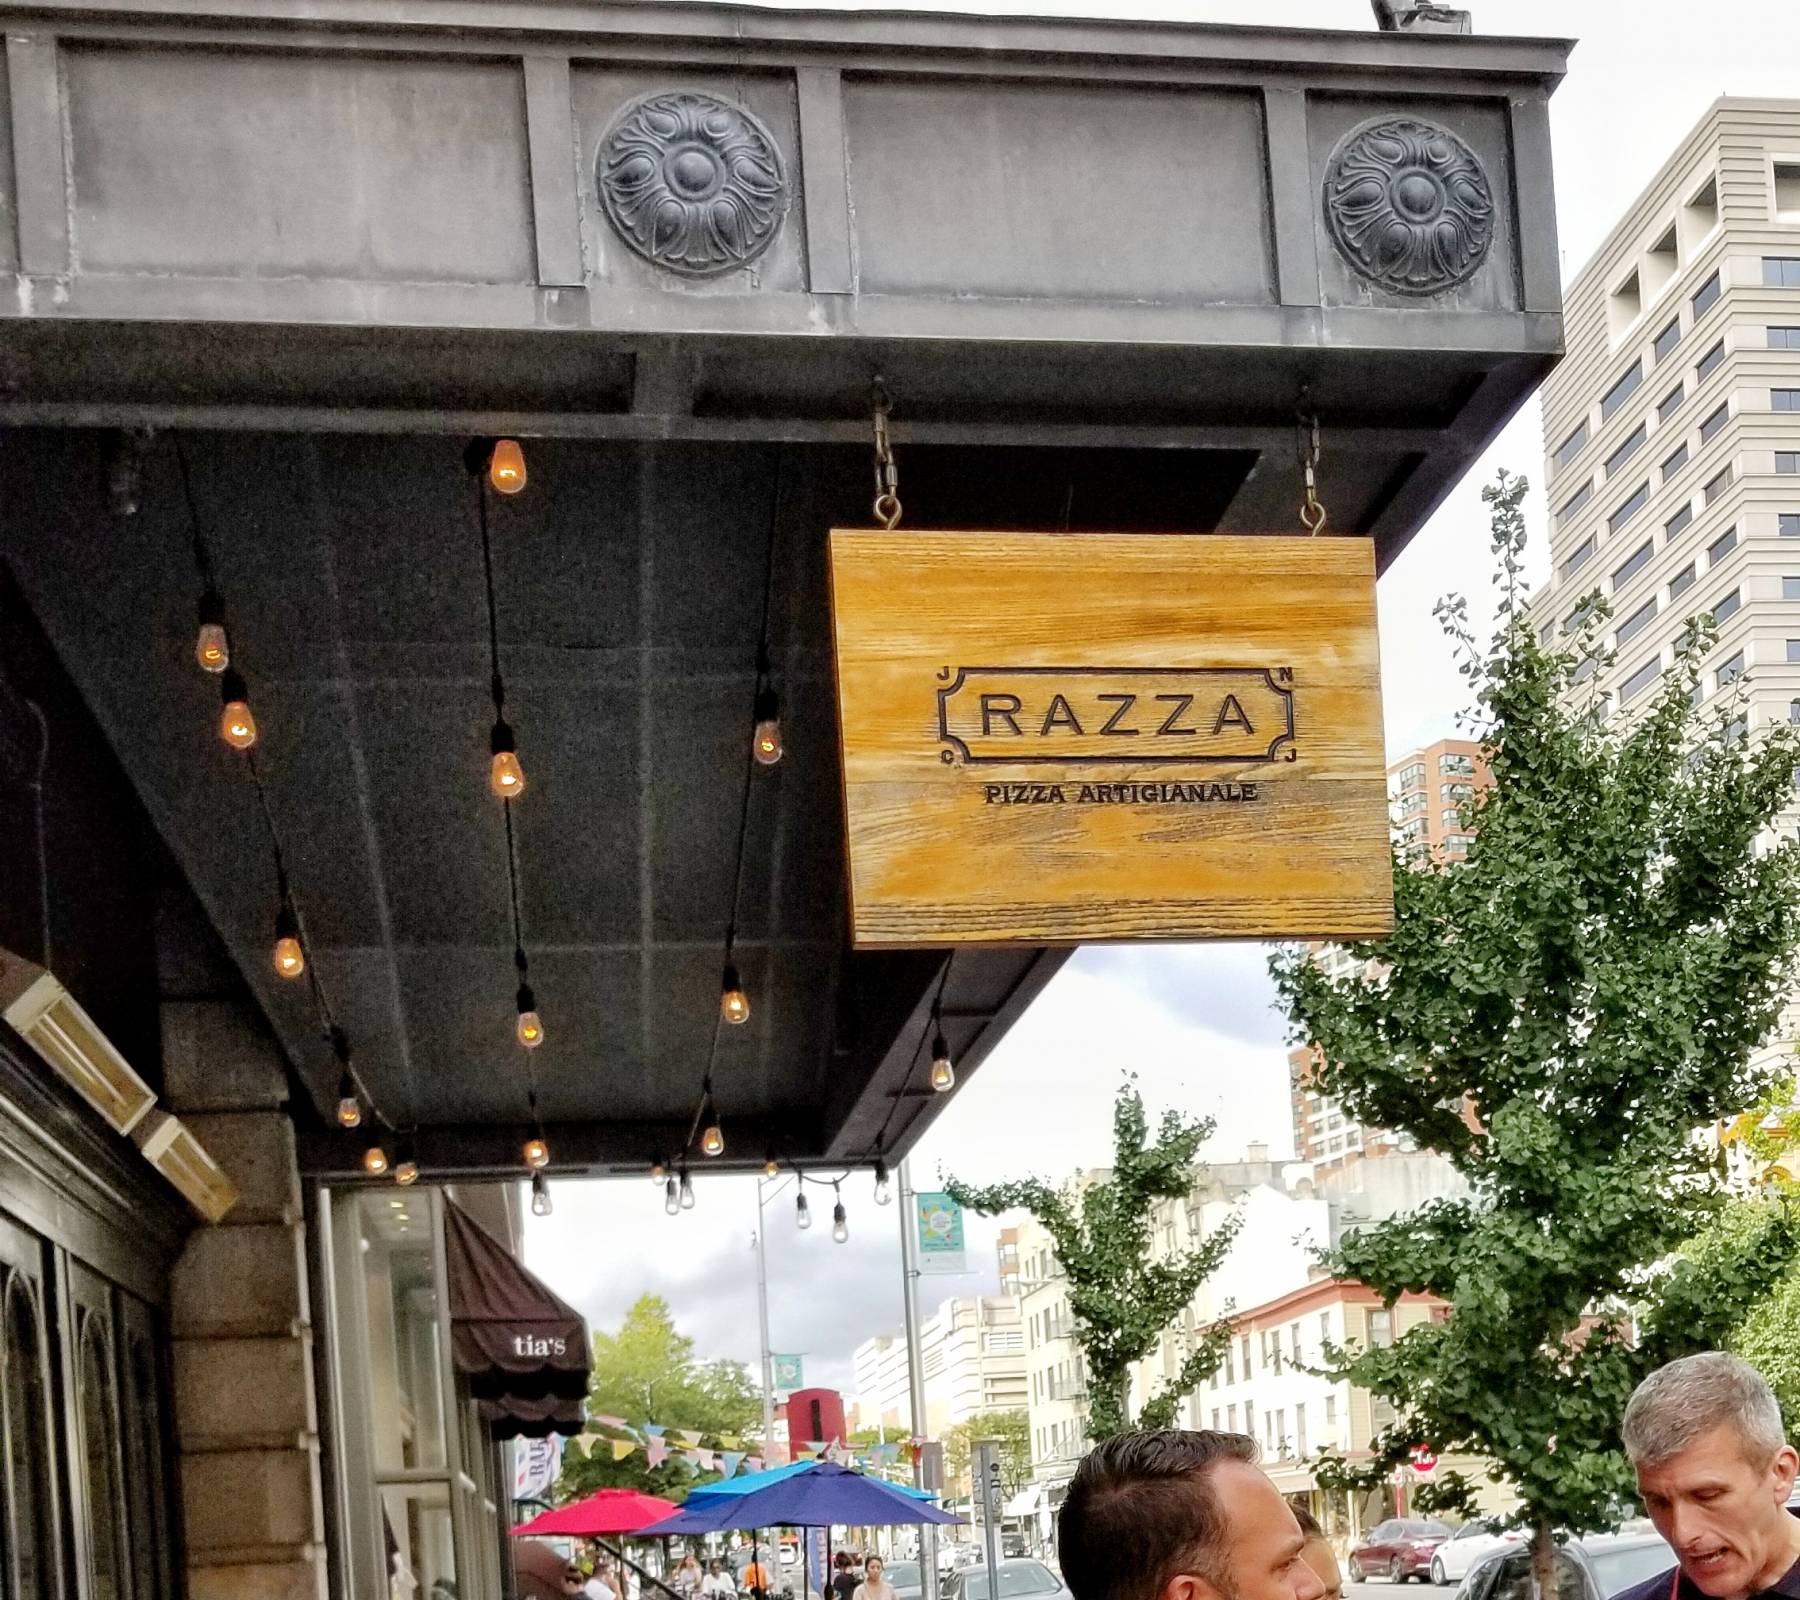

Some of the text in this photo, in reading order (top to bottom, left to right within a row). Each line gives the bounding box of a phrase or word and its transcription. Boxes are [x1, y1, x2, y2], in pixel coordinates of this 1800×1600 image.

[936, 665, 950, 681] J
[1279, 667, 1294, 682] N
[980, 693, 1255, 736] RAZZA
[941, 749, 955, 764] C
[1284, 748, 1298, 763] J
[985, 783, 1259, 804] PIZZA ARTIGIANALE
[513, 1334, 566, 1357] tia's
